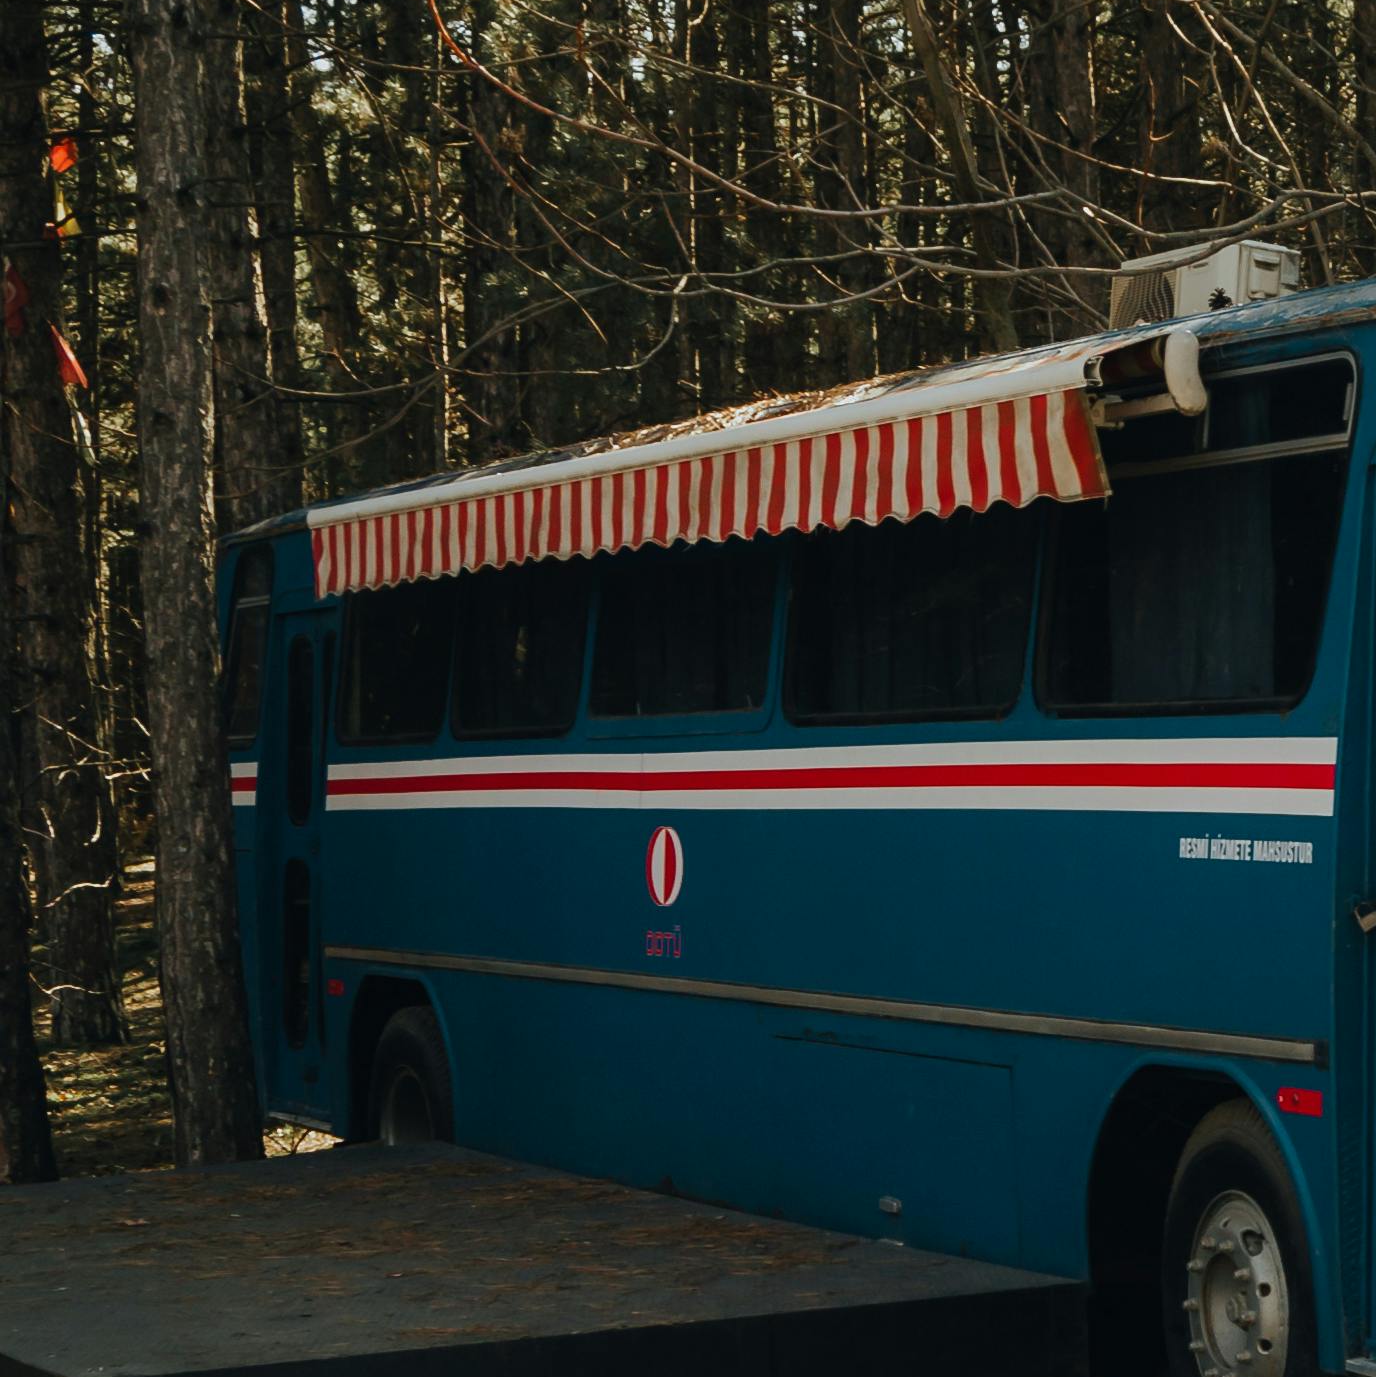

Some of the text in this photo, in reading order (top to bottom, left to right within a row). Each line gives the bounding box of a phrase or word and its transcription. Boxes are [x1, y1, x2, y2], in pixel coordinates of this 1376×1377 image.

[1179, 833, 1313, 864] RESMİ HİZMETE MAHSUSTUR
[646, 924, 682, 958] ODTÜ
